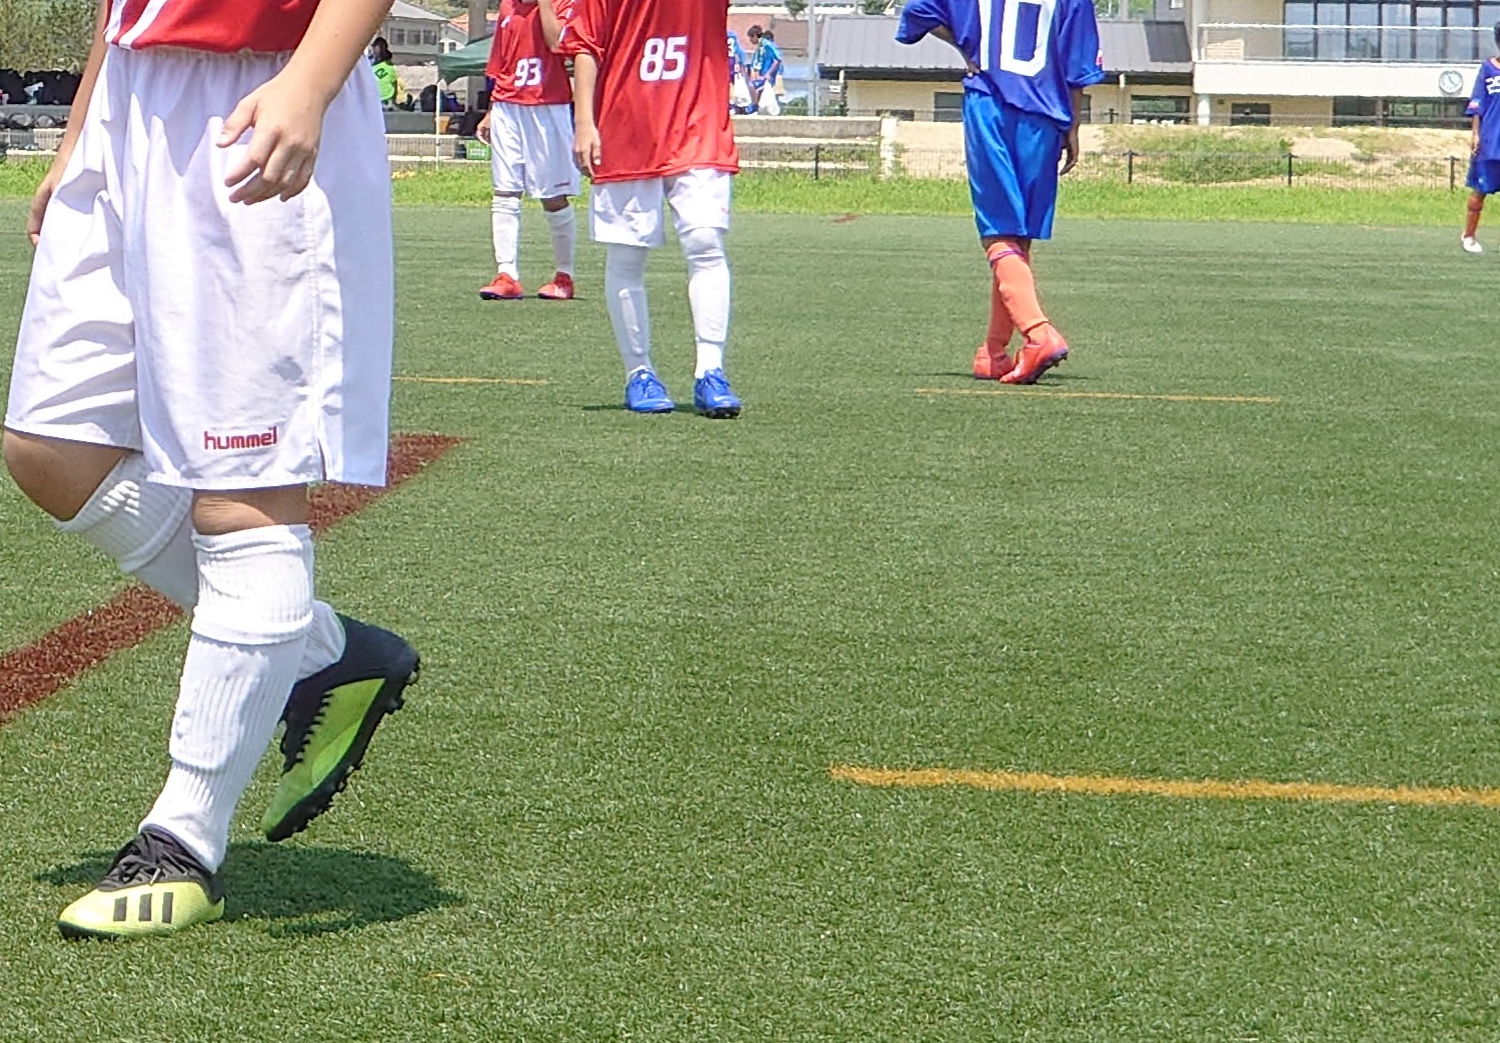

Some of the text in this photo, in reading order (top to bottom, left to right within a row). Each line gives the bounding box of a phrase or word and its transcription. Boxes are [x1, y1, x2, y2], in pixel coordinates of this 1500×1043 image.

[514, 58, 542, 87] 93
[639, 36, 687, 82] 85
[204, 425, 278, 450] hummel
